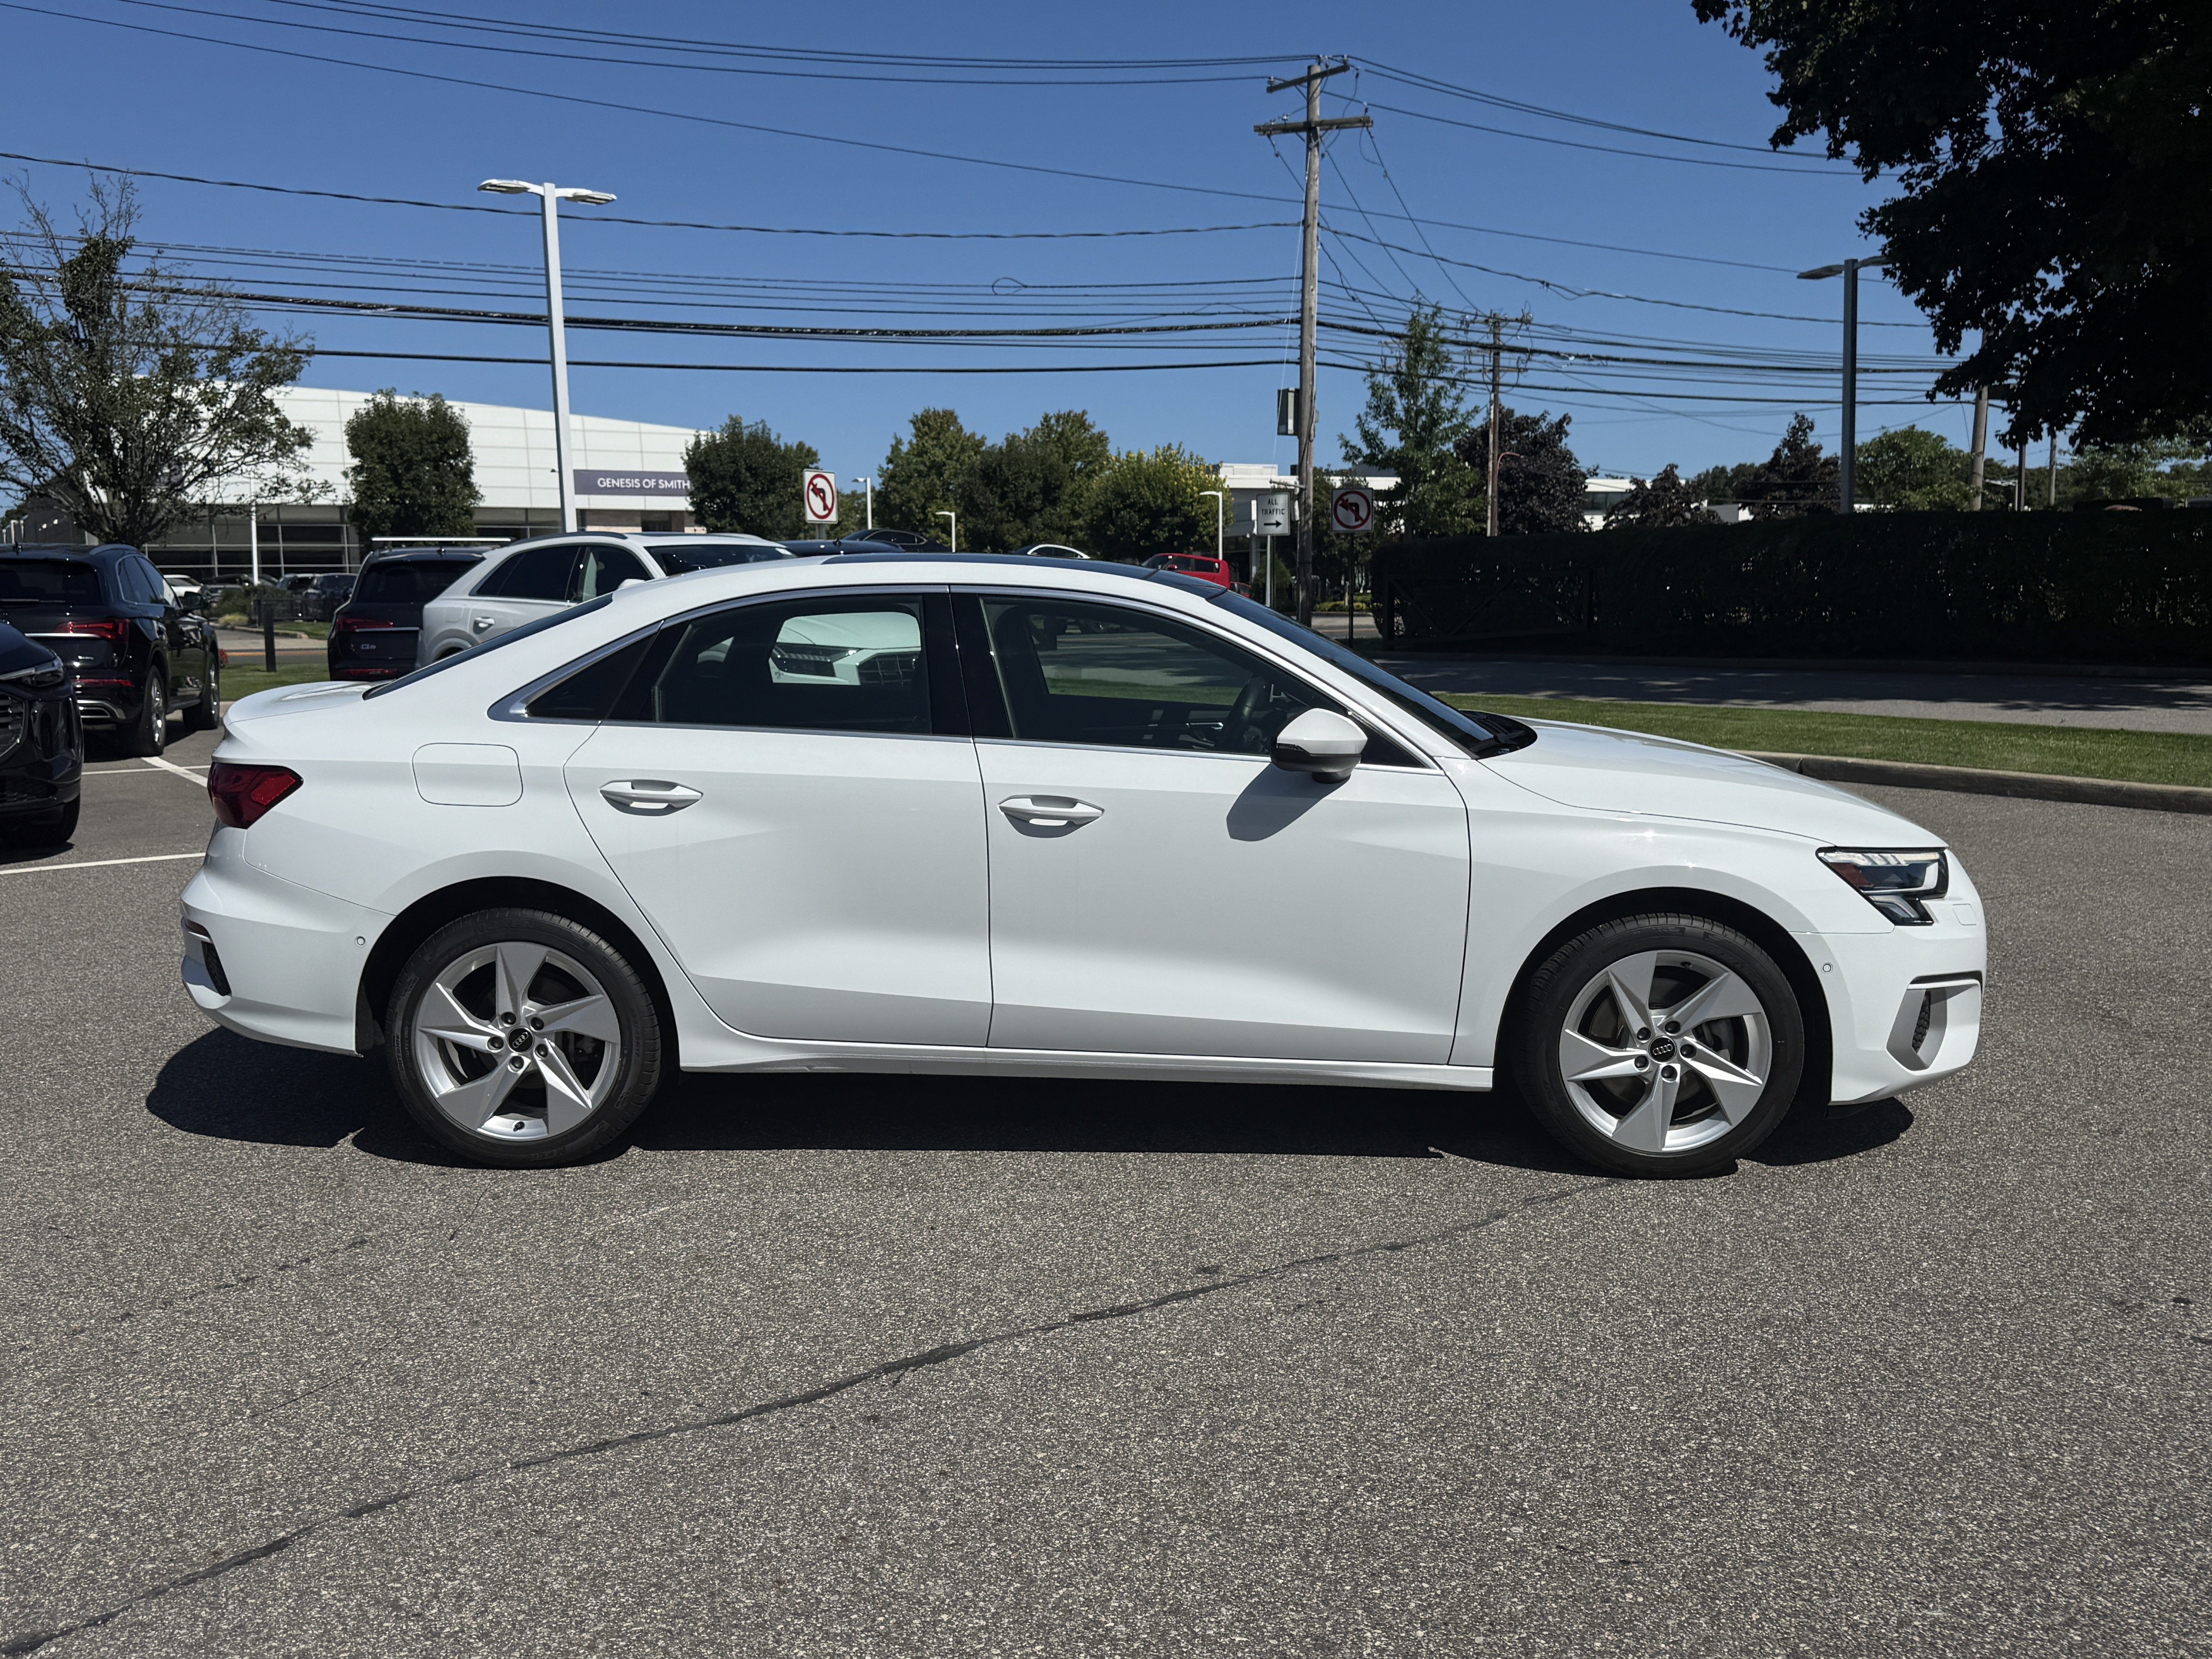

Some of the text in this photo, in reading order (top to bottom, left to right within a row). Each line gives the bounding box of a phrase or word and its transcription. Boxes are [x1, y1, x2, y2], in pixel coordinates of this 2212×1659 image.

[597, 477, 690, 489] GENESIS OF SMITH
[395, 1033, 404, 1071] OUTSIDE
